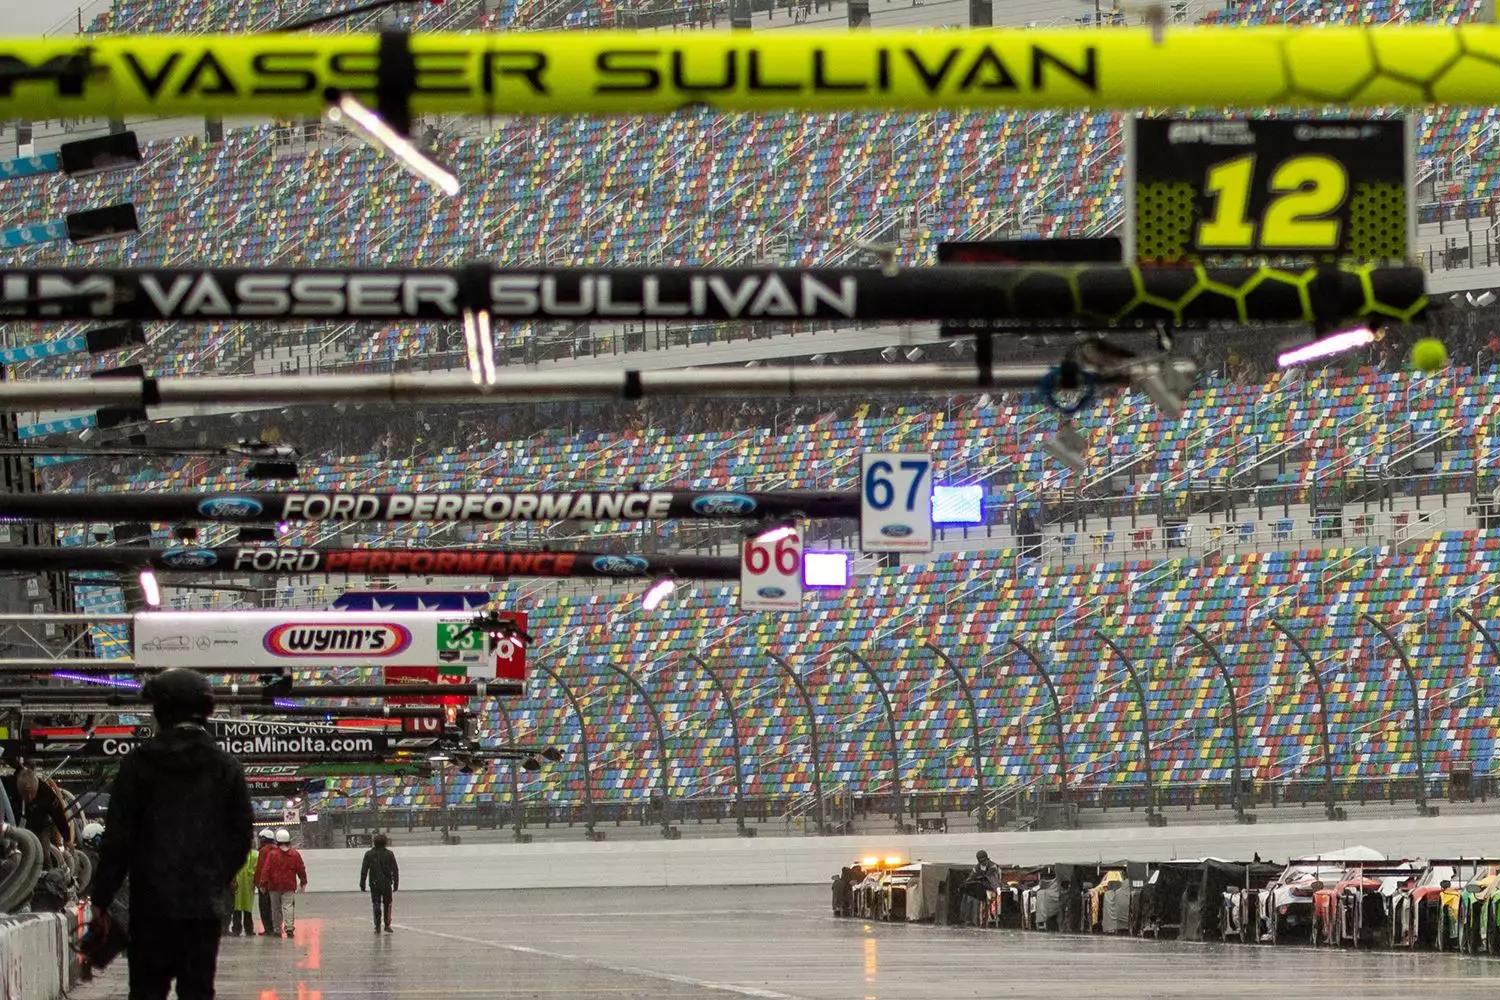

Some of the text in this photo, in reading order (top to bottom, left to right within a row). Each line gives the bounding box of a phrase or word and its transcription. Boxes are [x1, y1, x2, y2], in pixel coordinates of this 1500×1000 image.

[120, 49, 551, 101] VASSER
[595, 45, 1098, 95] SULLIVAN
[1198, 153, 1348, 249] 12
[138, 273, 459, 317] VASSER
[490, 272, 857, 318] SULLIVAN
[282, 494, 379, 521] FORD
[386, 492, 673, 520] PERFORMANCE
[865, 460, 929, 512] 67
[235, 549, 320, 572] FORD
[325, 550, 576, 576] PERFORMANCE
[744, 531, 800, 576] 66
[225, 722, 335, 736] MOTORSPORTS
